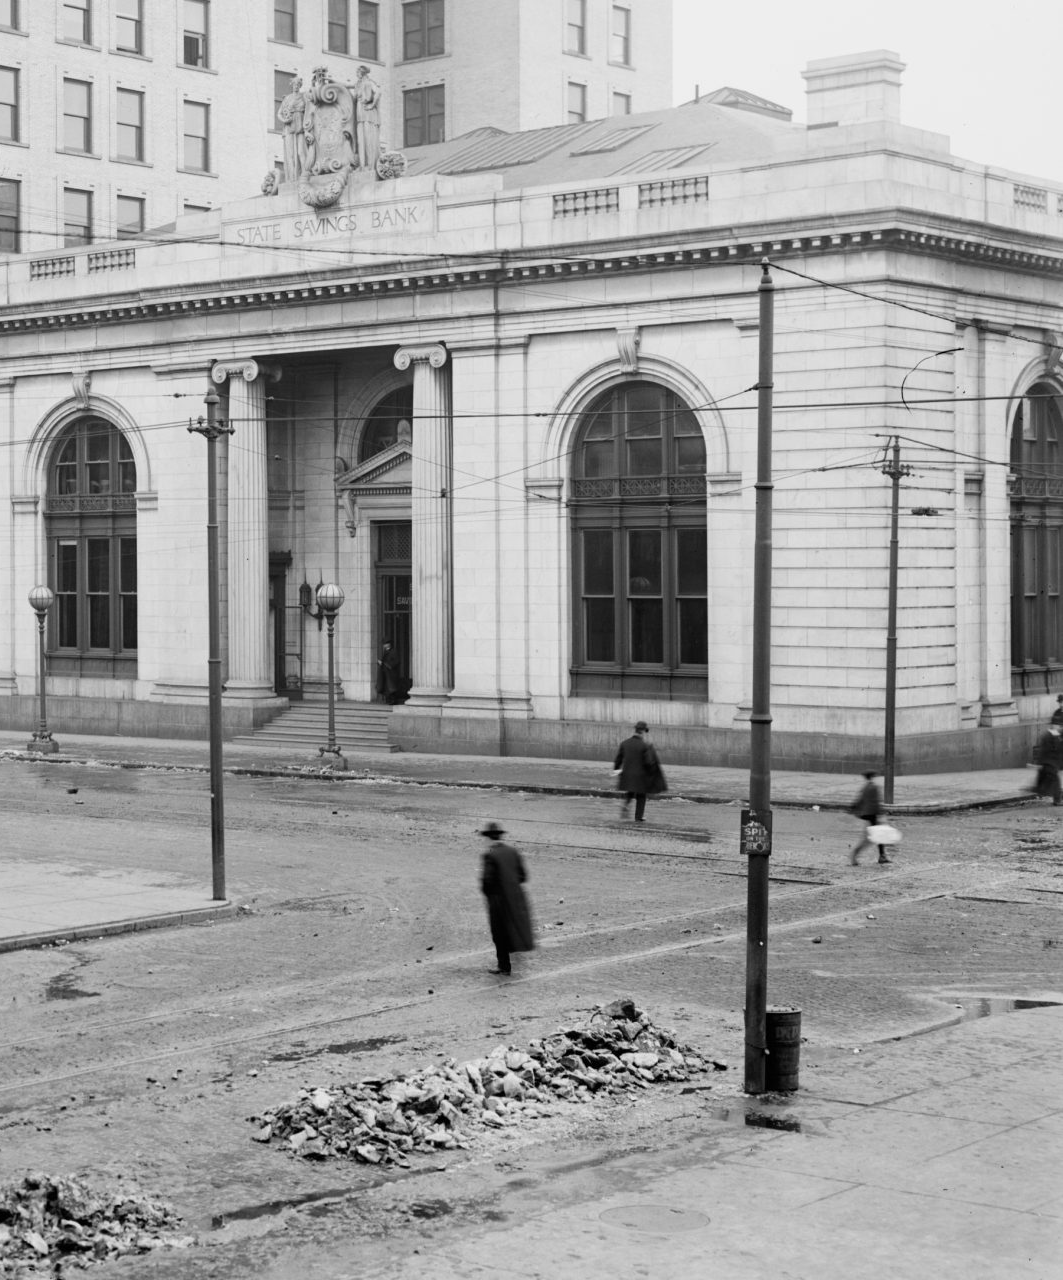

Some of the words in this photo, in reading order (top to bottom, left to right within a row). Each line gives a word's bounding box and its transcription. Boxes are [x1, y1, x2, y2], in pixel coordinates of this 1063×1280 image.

[236, 223, 282, 246] STATE
[293, 214, 358, 239] SAVINGS
[370, 206, 419, 229] BANK
[744, 827, 768, 836] SPIT
